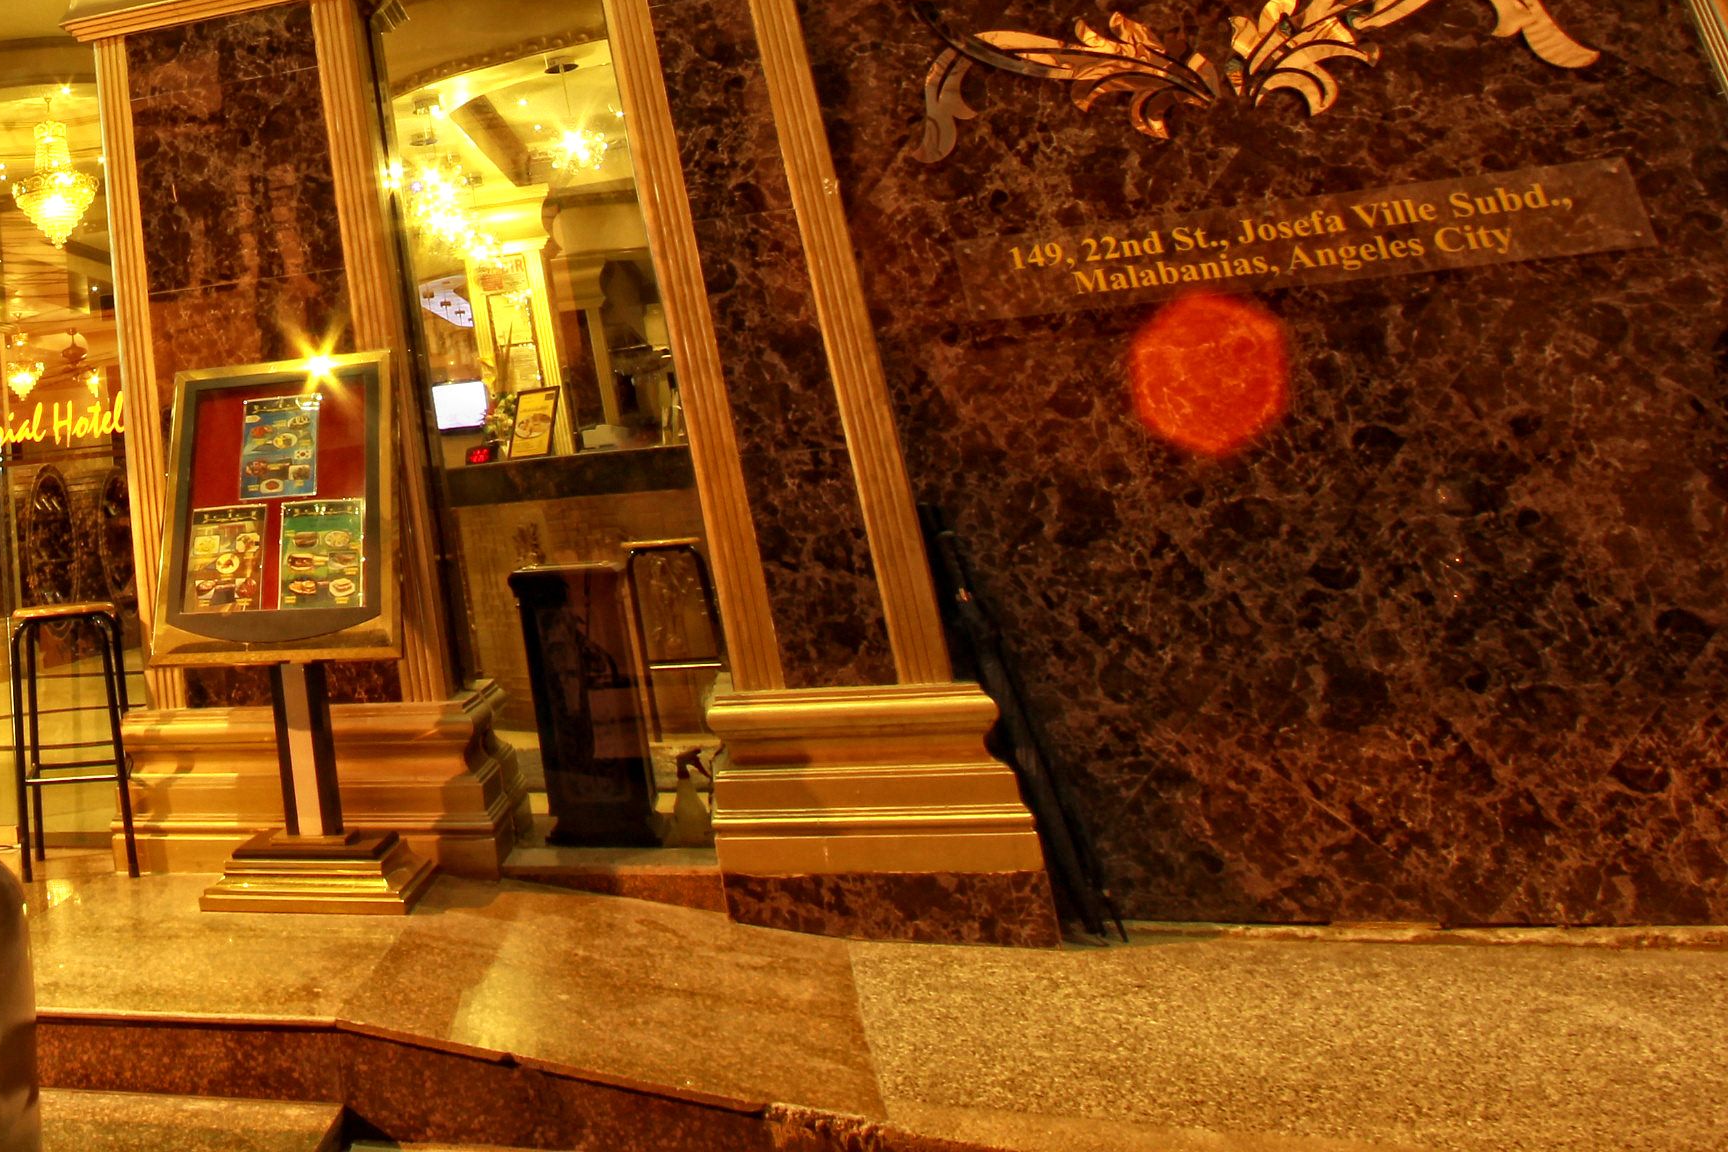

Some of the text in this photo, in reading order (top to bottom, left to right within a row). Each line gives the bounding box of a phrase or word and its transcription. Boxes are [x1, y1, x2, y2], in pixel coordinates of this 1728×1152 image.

[1008, 182, 1573, 270] 149, 22nd St., Josefa Ville Subd.,
[1072, 224, 1513, 295] Malabanias, Angeles City
[53, 390, 125, 448] Hotel
